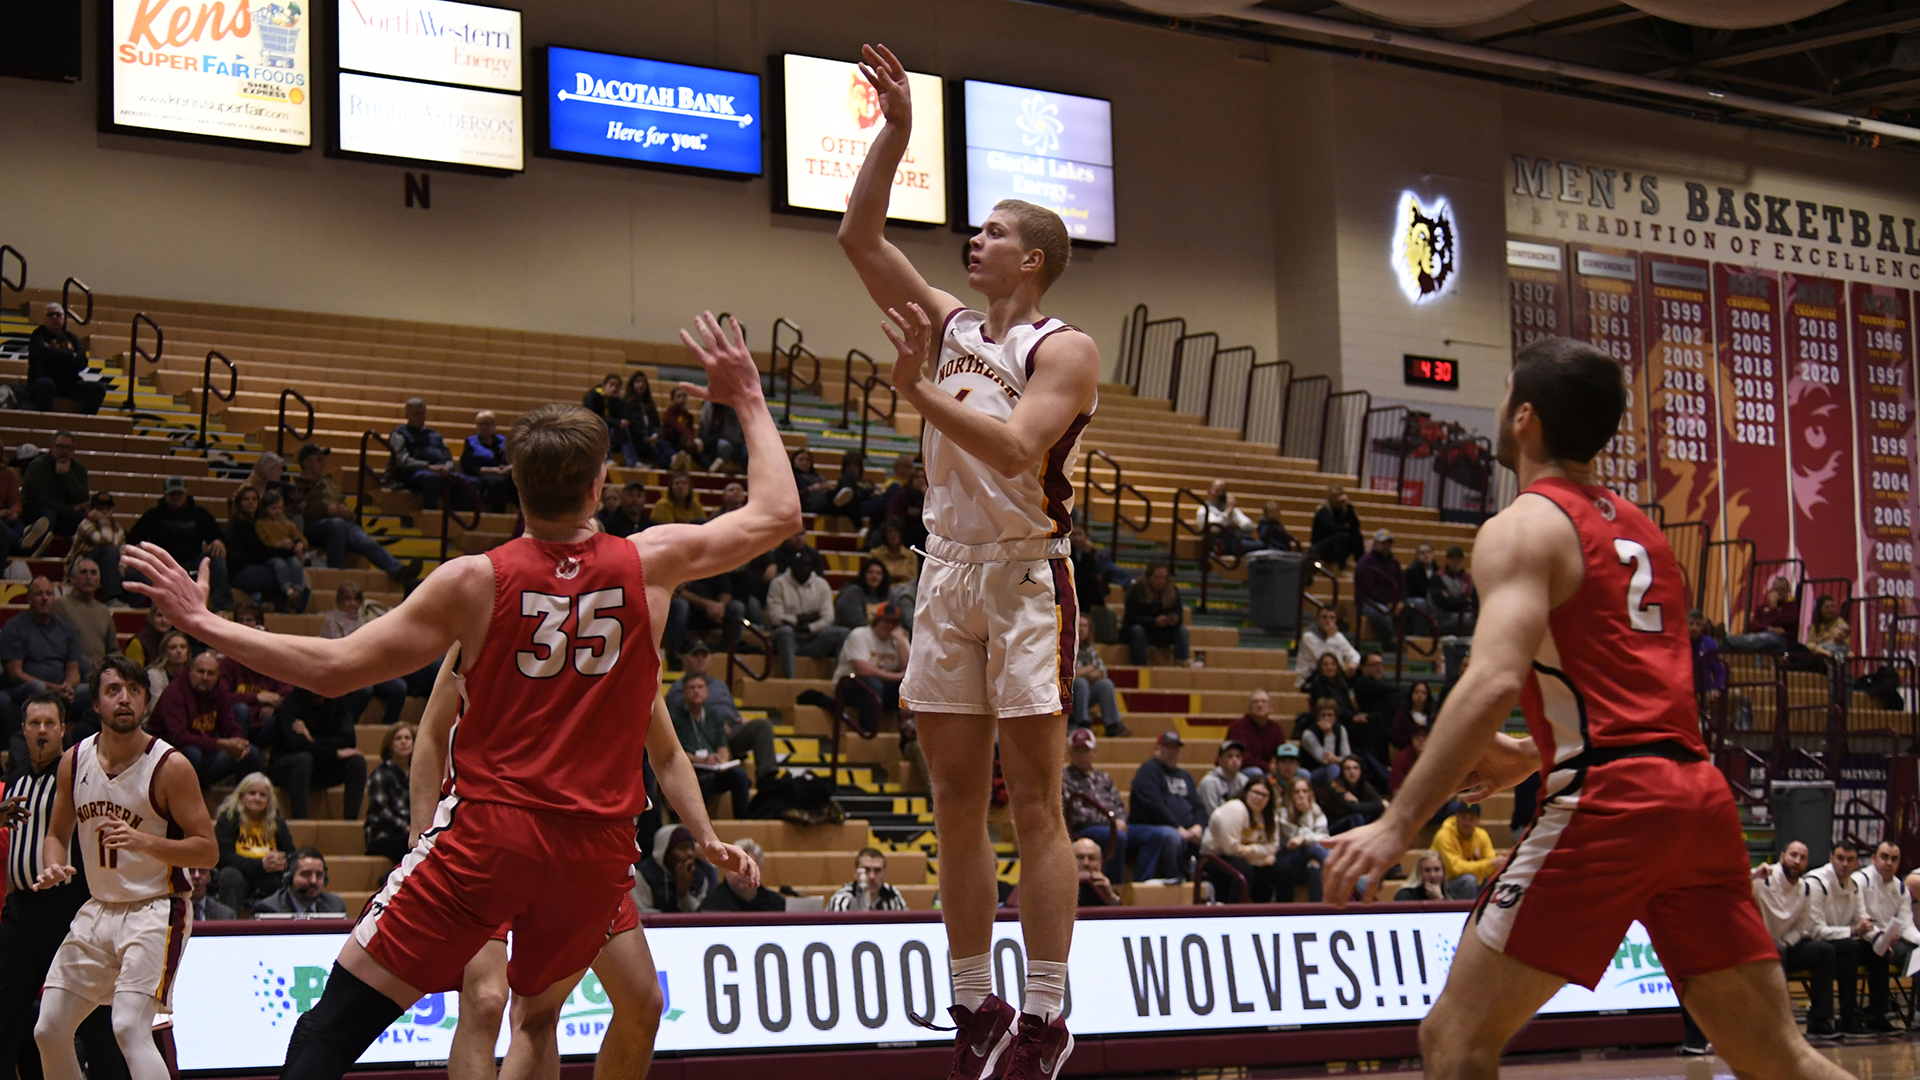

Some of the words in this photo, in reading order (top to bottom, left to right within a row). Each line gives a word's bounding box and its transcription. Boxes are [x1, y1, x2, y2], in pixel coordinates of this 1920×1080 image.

[119, 44, 198, 71] SUPER
[203, 54, 250, 79] FAIR
[254, 68, 305, 86] FOODS
[454, 46, 512, 78] Energy
[243, 88, 287, 99] EXPRESS
[247, 82, 282, 92] SHELL
[576, 72, 674, 107] DACOTAH
[678, 86, 736, 115] BANK
[606, 121, 644, 143] Here
[643, 126, 669, 148] for
[821, 136, 915, 164] OFFIL
[805, 157, 861, 179] TEAM
[987, 150, 1045, 177] Glacial
[1049, 159, 1095, 183] Lakes
[405, 171, 431, 209] N
[892, 169, 930, 190] ORE
[1013, 174, 1068, 203] Energy
[1513, 155, 1660, 215] MEN'S
[1556, 208, 1716, 250] TRADITION
[1731, 236, 1761, 256] OF
[1512, 281, 1555, 305] 1907
[1588, 290, 1630, 314] 1960
[1513, 304, 1557, 329] 1908
[1661, 300, 1702, 323] 1999
[1731, 309, 1771, 332] 2004
[1589, 314, 1630, 337] 1961
[1662, 323, 1703, 346] 2002
[1798, 317, 1838, 340] 2018
[1732, 332, 1772, 355] 2005
[1800, 340, 1839, 363] 2019
[1866, 329, 1903, 352] 1996
[1662, 346, 1704, 370] 2003
[1733, 355, 1773, 378] 2018
[1663, 369, 1705, 393] 2018
[1801, 363, 1840, 385] 2020
[1868, 365, 1904, 387] 1997
[1734, 378, 1774, 401] 2019
[1664, 393, 1706, 416] 2019
[1735, 400, 1775, 423] 2020
[1870, 400, 1907, 422] 1998
[1665, 416, 1707, 439] 2020
[1736, 423, 1776, 446] 2021
[1667, 439, 1708, 463] 2021
[1871, 435, 1908, 457] 1999
[1595, 456, 1638, 479] 1976
[1872, 471, 1909, 493] 2004
[1874, 506, 1911, 528] 2005
[1875, 542, 1913, 563] 2006
[1613, 537, 1664, 633] 2
[1877, 577, 1915, 598] 2008
[515, 586, 624, 680] 35
[77, 801, 144, 829] NORTHERN
[1122, 929, 1431, 1017] WOLVES!!!
[1638, 981, 1673, 994] SUPP
[378, 1028, 415, 1044] PLY
[565, 1022, 604, 1037] SUP
